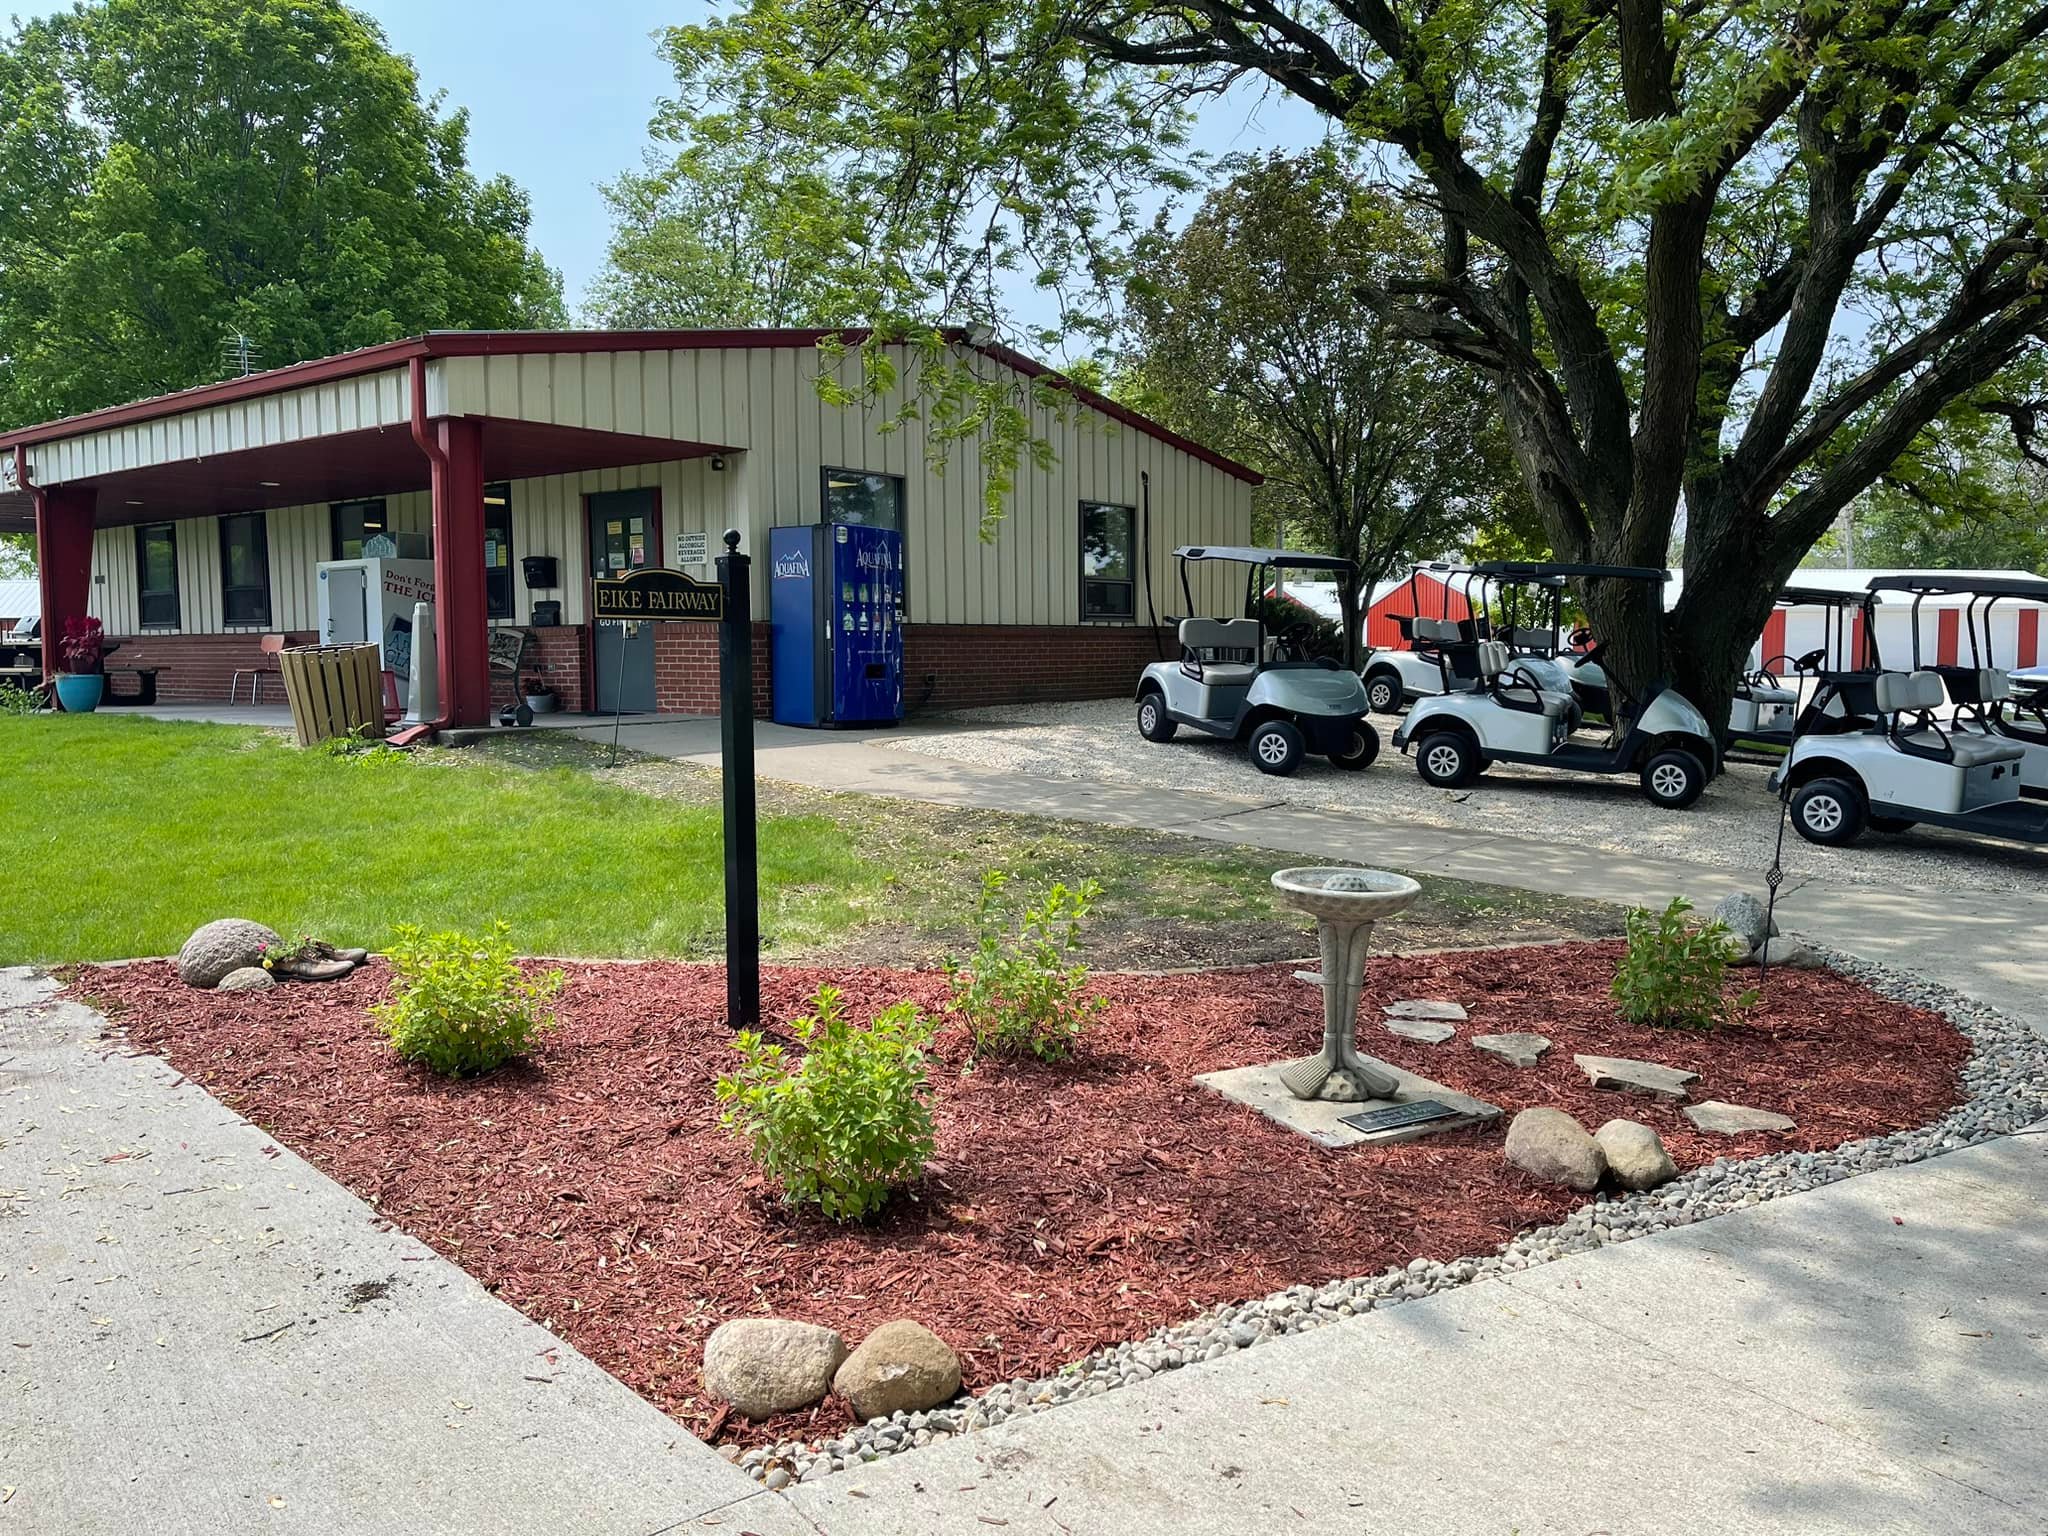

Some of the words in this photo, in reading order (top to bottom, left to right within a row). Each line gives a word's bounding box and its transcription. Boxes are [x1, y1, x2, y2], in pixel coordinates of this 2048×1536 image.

[685, 534, 706, 542] OUTSIDE
[774, 557, 810, 578] AQUAFINA
[385, 570, 412, 585] Don't
[384, 581, 413, 598] THE
[599, 589, 642, 608] EIKE
[647, 591, 719, 610] FAIRWAY
